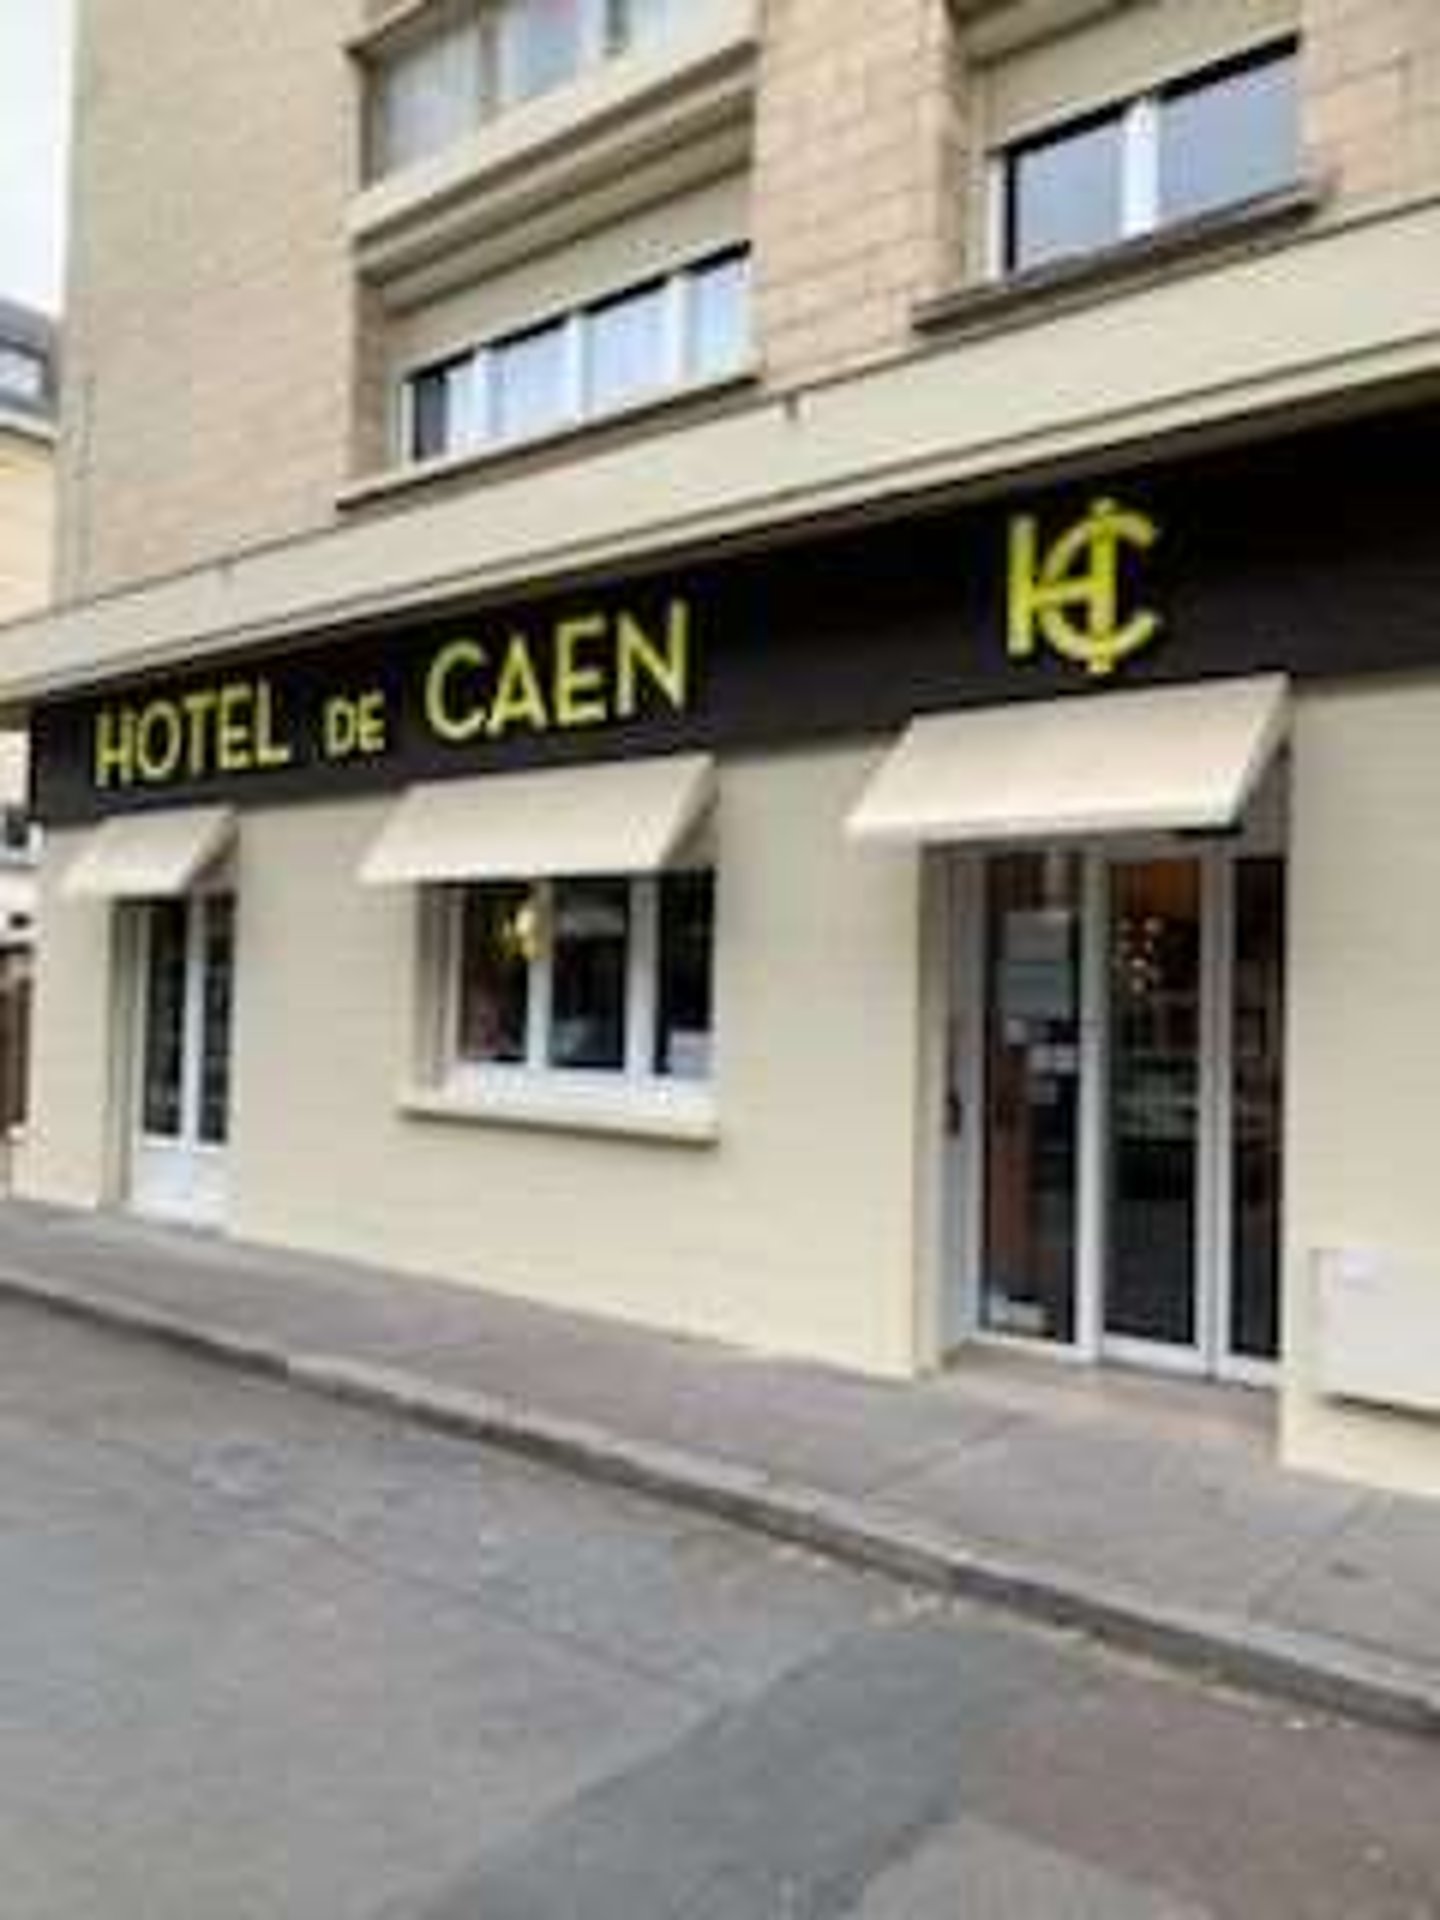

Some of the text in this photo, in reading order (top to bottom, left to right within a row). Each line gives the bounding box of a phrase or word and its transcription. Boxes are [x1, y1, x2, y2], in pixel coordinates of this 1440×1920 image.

[96, 599, 690, 787] HOTEL DE CAEN
